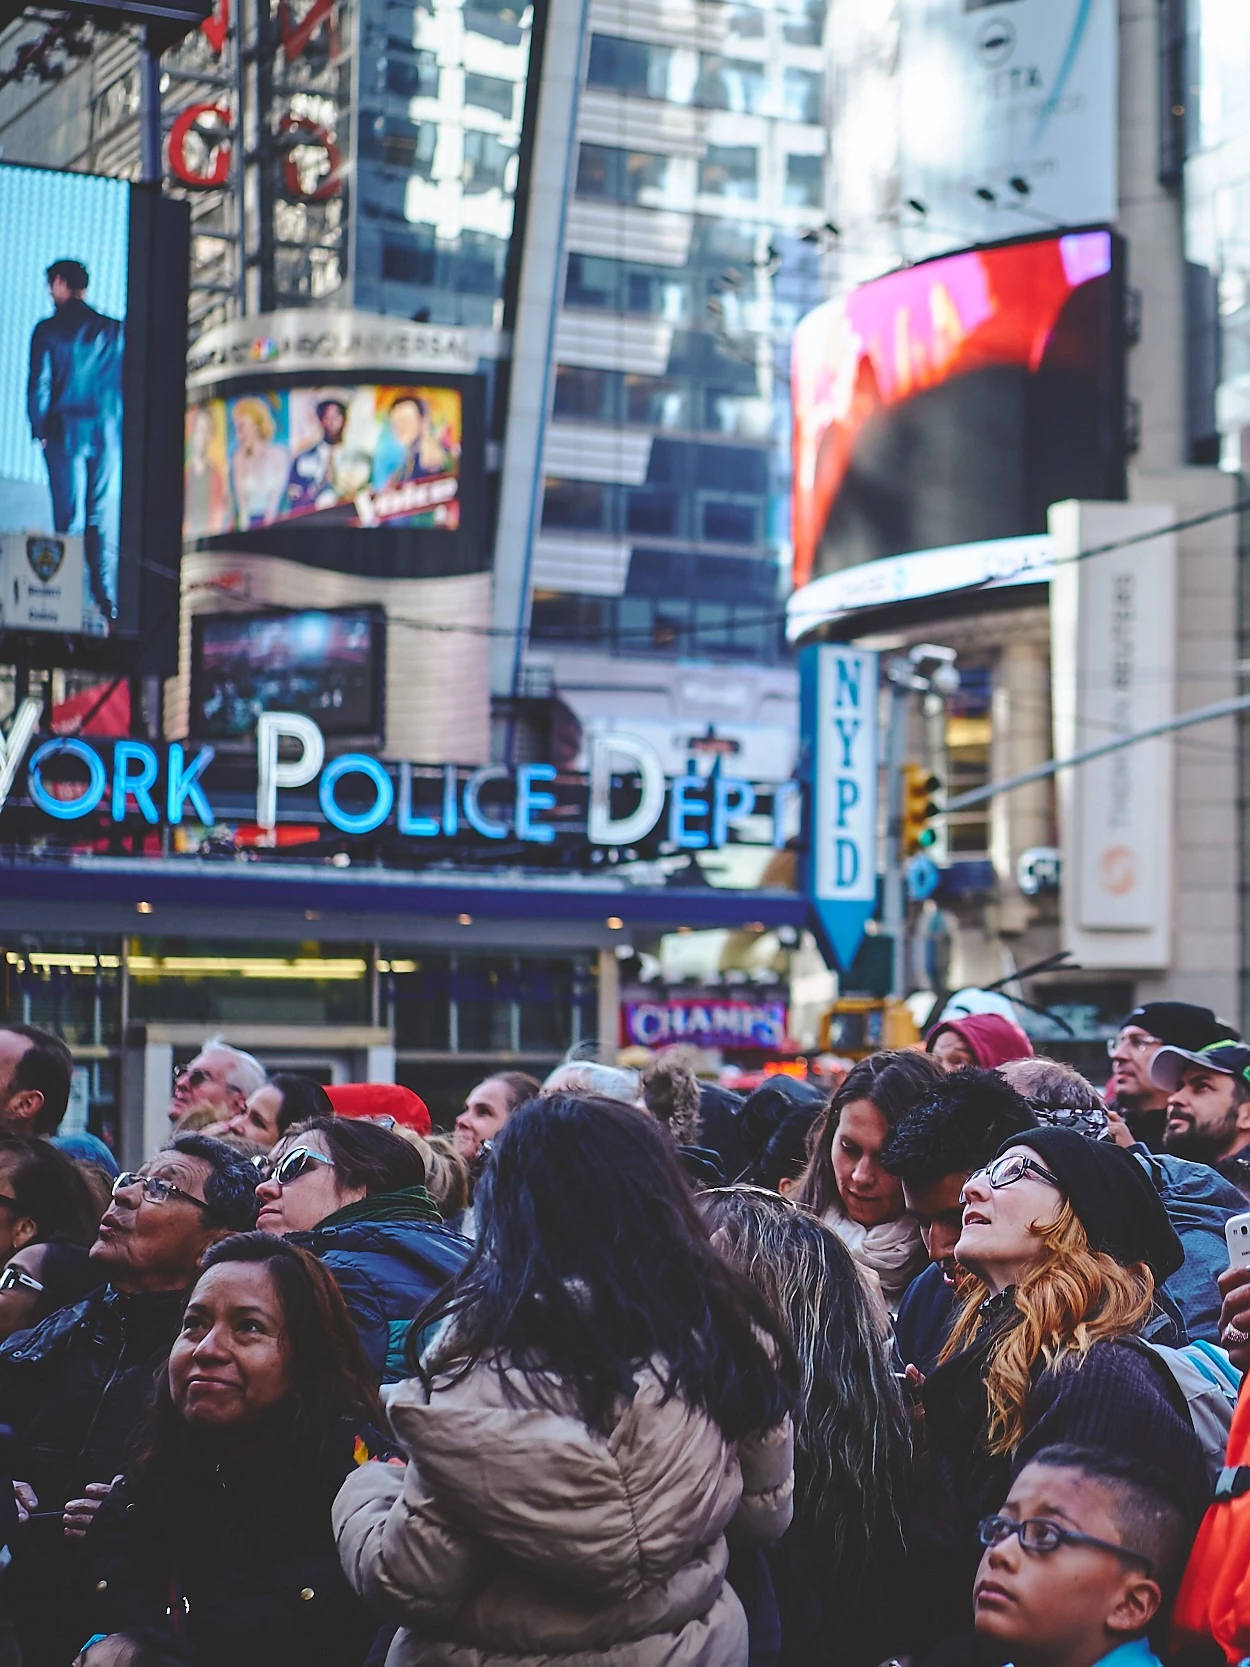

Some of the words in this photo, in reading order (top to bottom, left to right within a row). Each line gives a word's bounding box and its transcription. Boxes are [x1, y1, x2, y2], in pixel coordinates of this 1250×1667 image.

[0, 697, 216, 826] YORK
[255, 710, 557, 844] POLICE
[835, 658, 861, 888] NYPD
